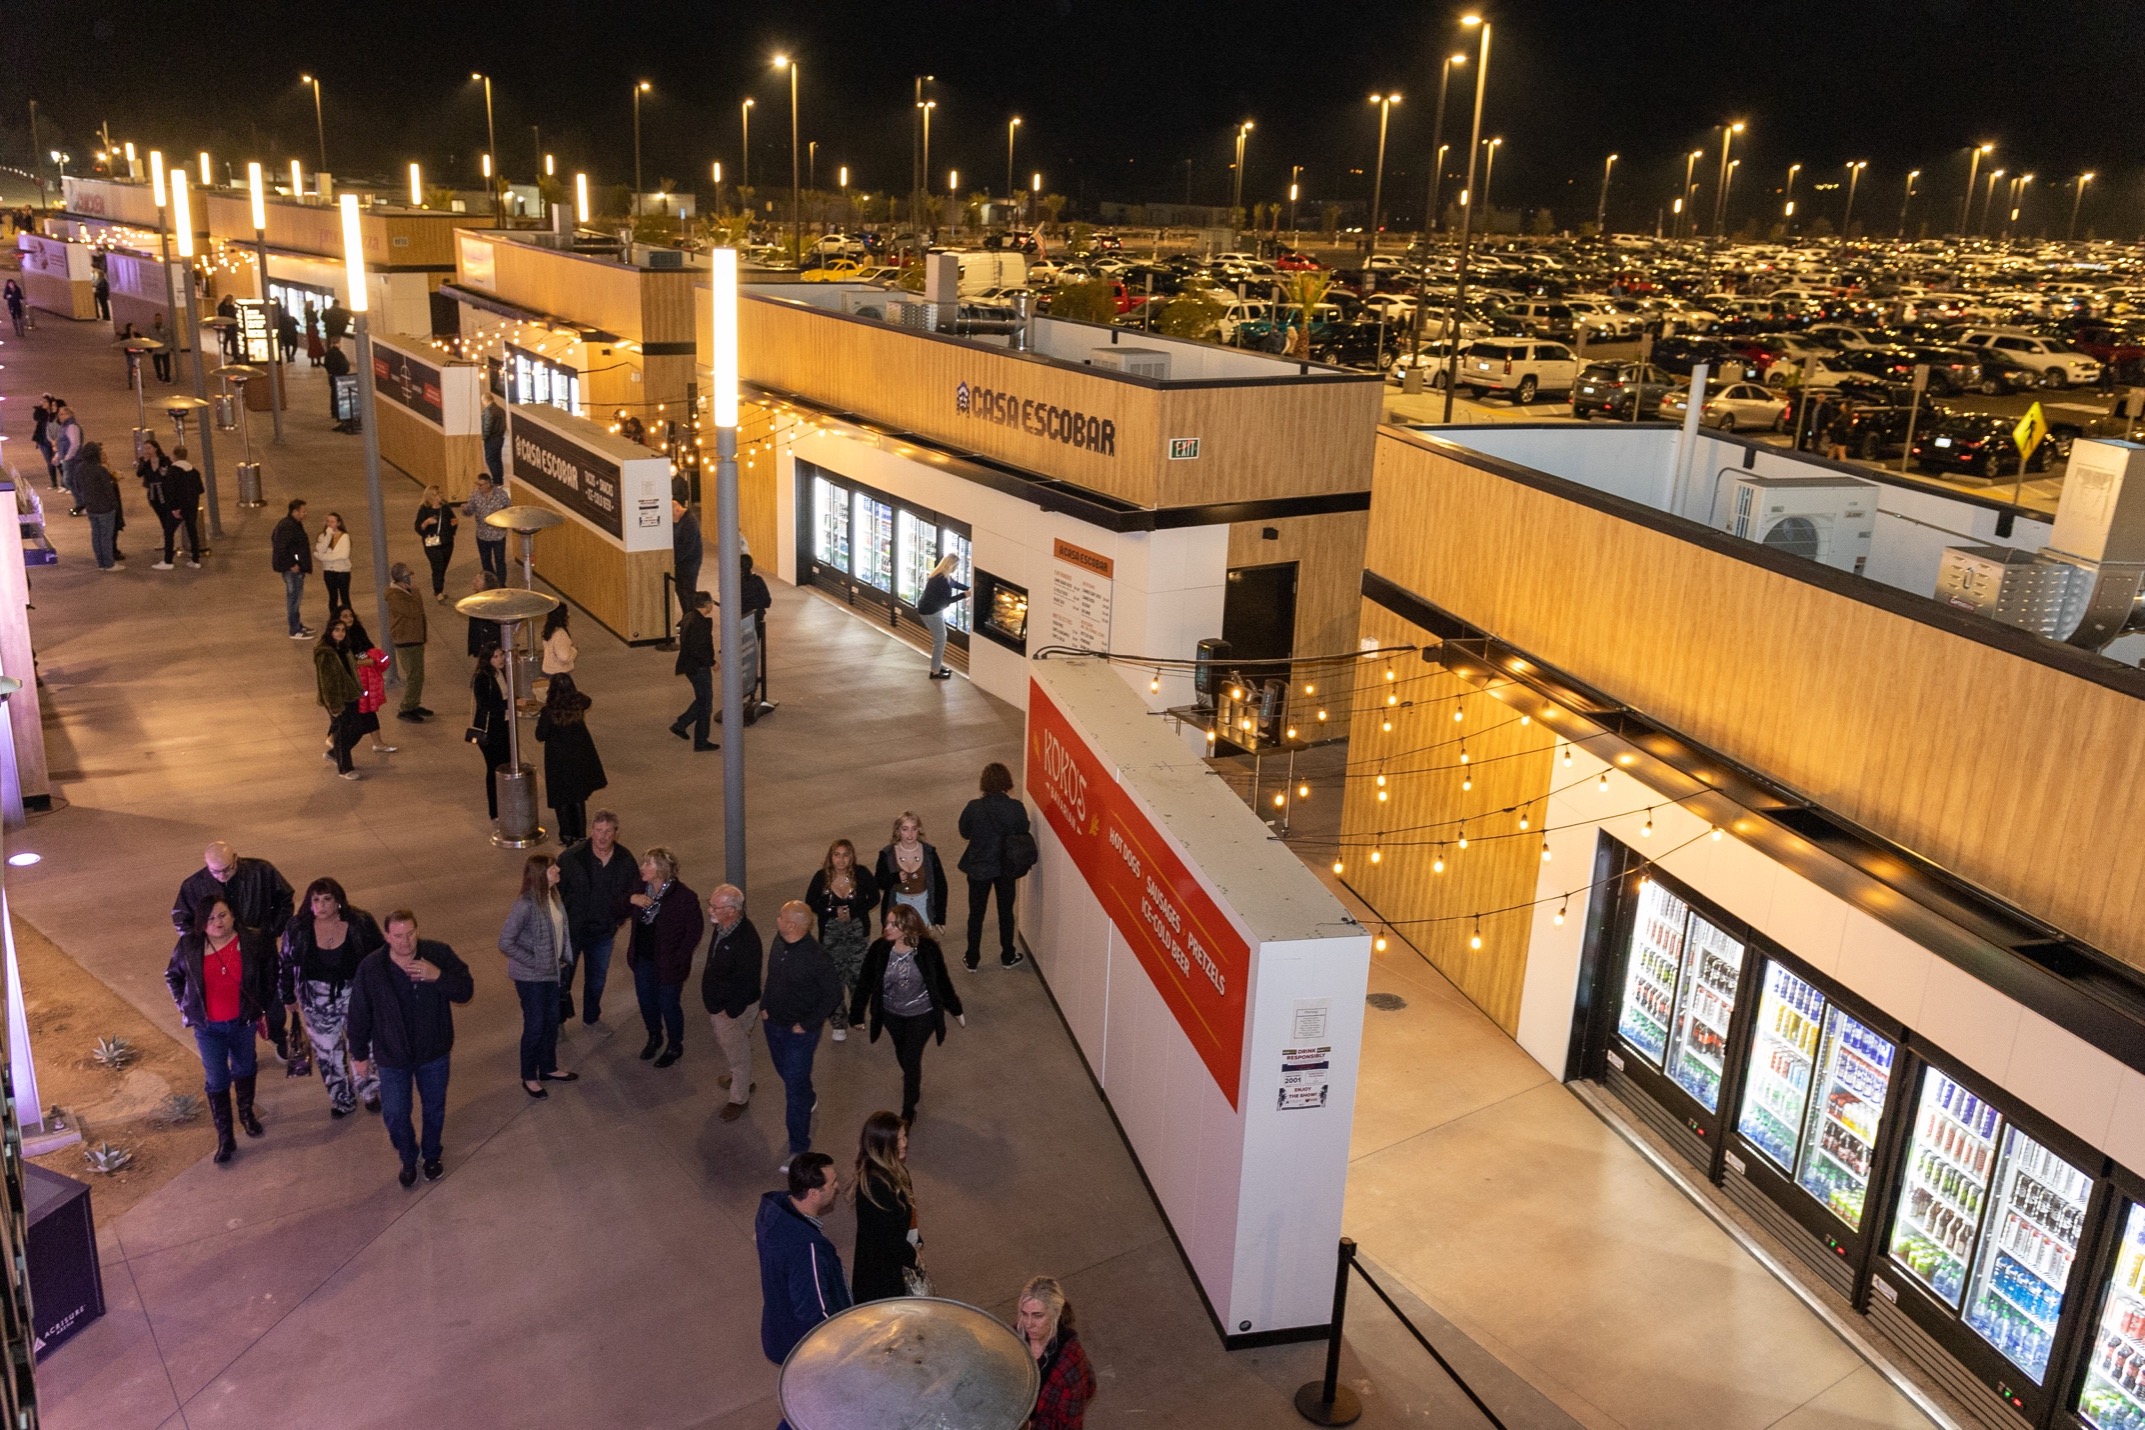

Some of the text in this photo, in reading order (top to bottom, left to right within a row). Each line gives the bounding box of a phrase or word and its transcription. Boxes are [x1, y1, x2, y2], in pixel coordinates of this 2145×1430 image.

[972, 385, 1116, 457] CASA ESCOBAR
[1175, 440, 1196, 458] EXIT
[522, 438, 579, 491] CASA ESCOBAR
[1044, 728, 1087, 821] KOKO'S
[1109, 827, 1226, 997] HOT DOGS SAUSAGES PRETZELS
[1141, 896, 1190, 978] ICE-COLD BEER
[44, 1305, 84, 1338] ACRISURE
[56, 1321, 74, 1335] ARENA
